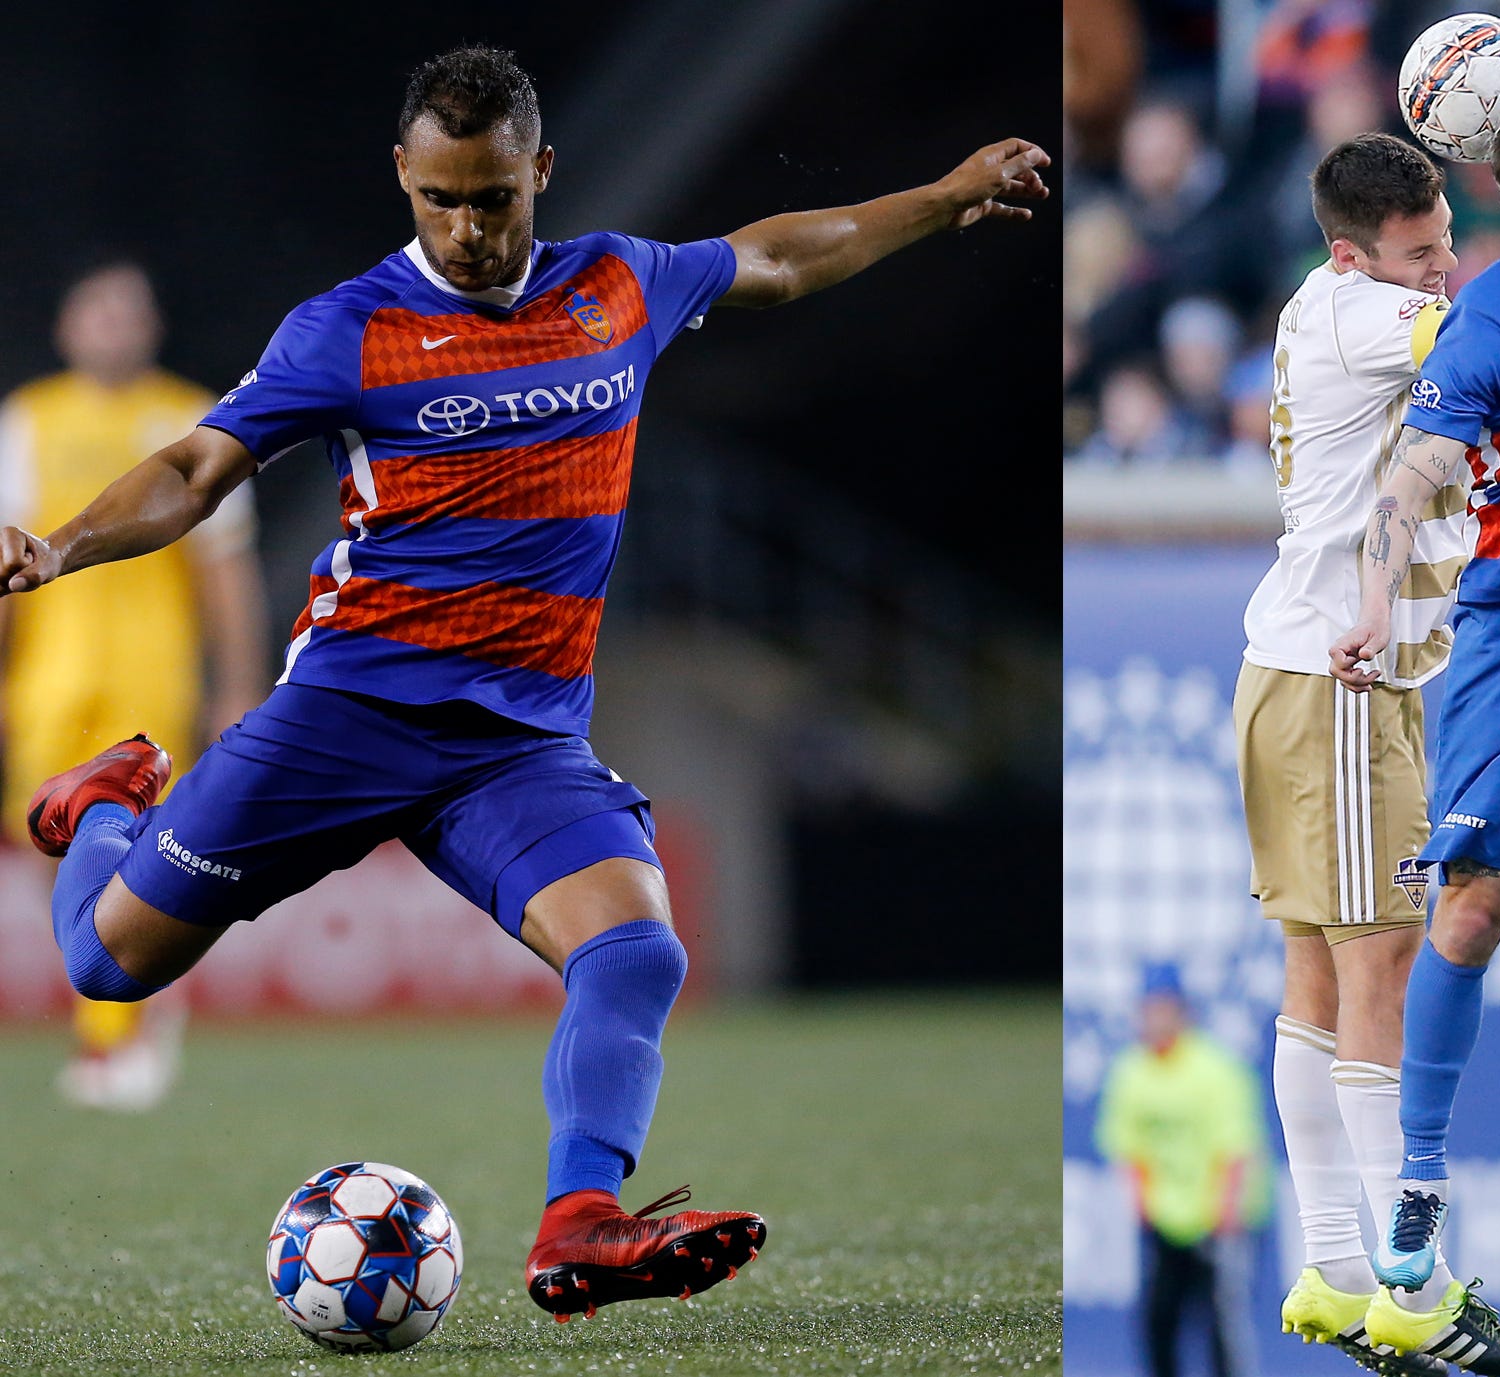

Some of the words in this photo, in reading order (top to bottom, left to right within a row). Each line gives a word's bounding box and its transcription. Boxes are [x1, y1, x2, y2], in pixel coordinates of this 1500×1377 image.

[577, 307, 604, 326] FC
[495, 364, 635, 422] TOYOTA
[158, 828, 242, 881] KINGSGATE
[162, 851, 197, 876] LOGISTICS
